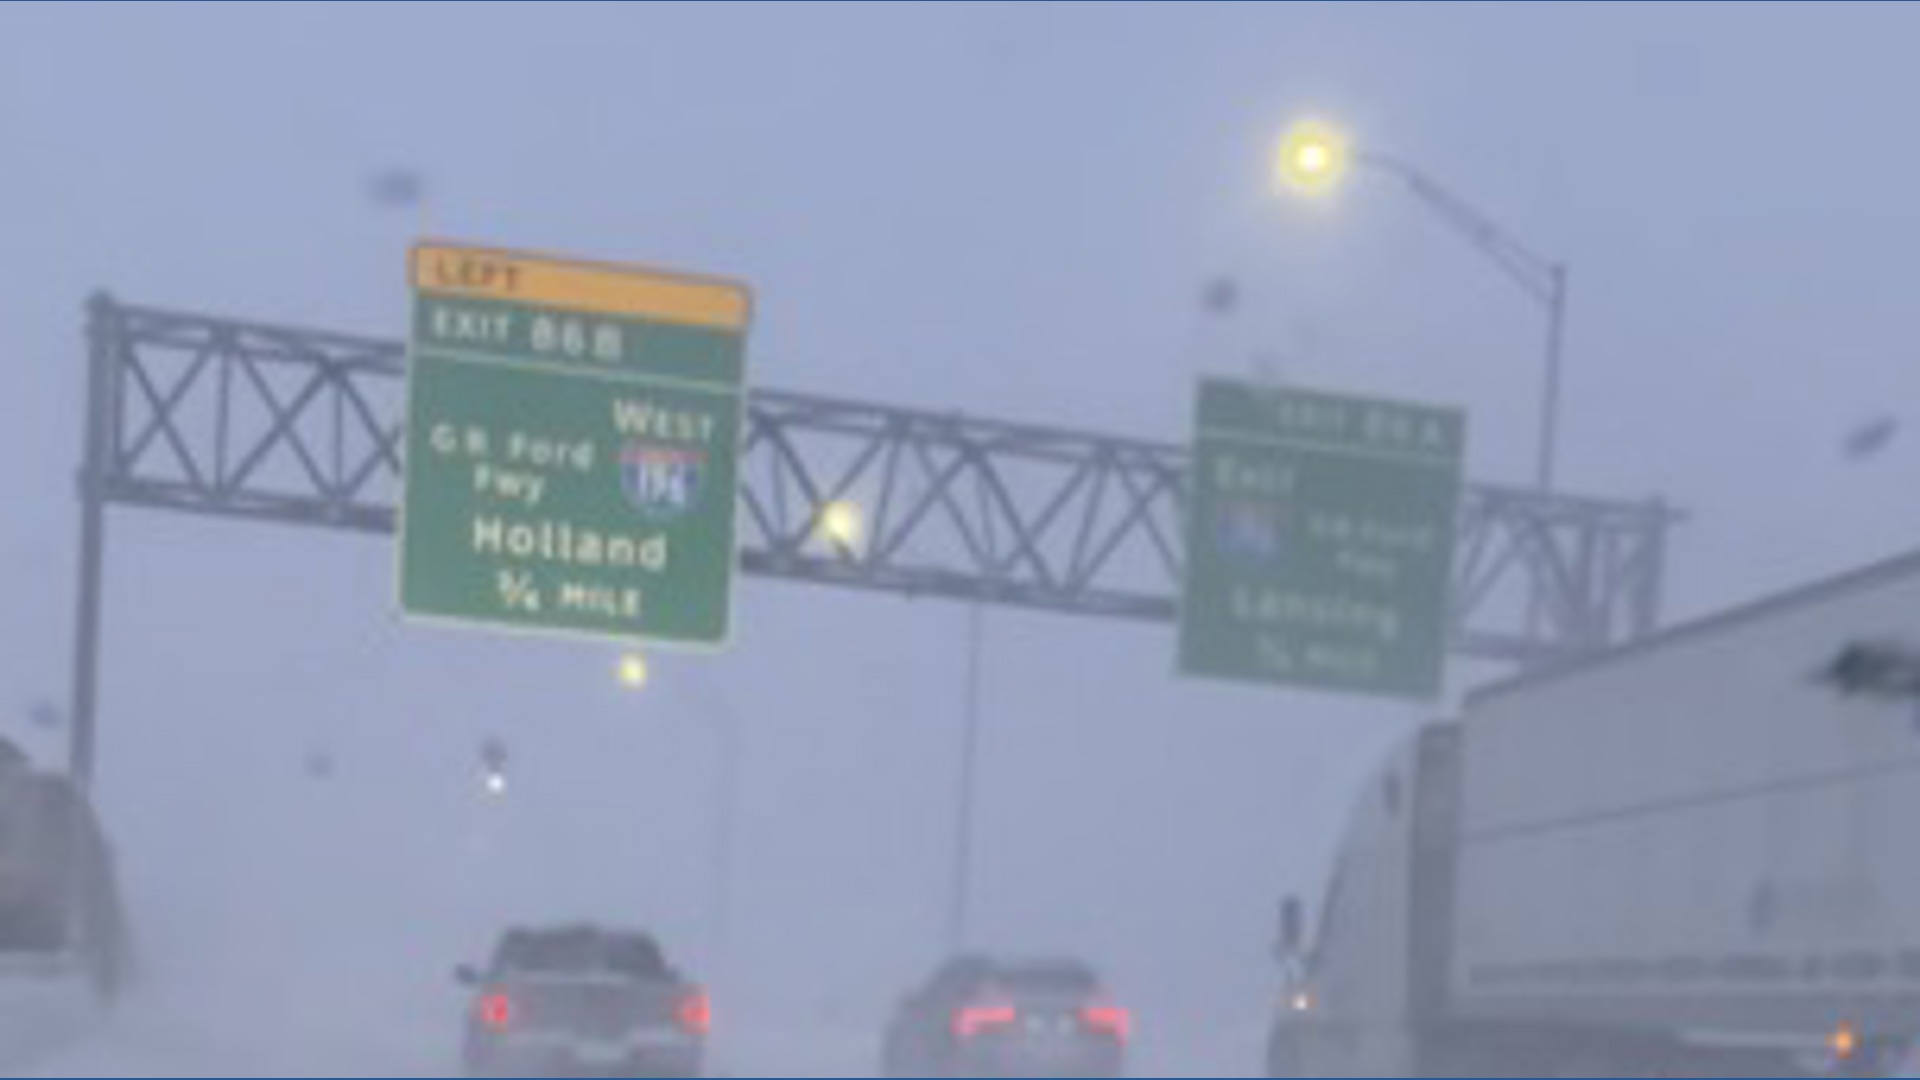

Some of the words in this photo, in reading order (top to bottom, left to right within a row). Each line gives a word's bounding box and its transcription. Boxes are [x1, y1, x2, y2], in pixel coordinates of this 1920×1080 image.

[435, 254, 522, 291] LEFT
[434, 307, 510, 341] EXIT
[612, 399, 715, 441] WEST
[508, 431, 596, 471] Ford
[474, 464, 546, 505] Fwy
[473, 514, 667, 572] Holland
[560, 583, 641, 617] MILE
